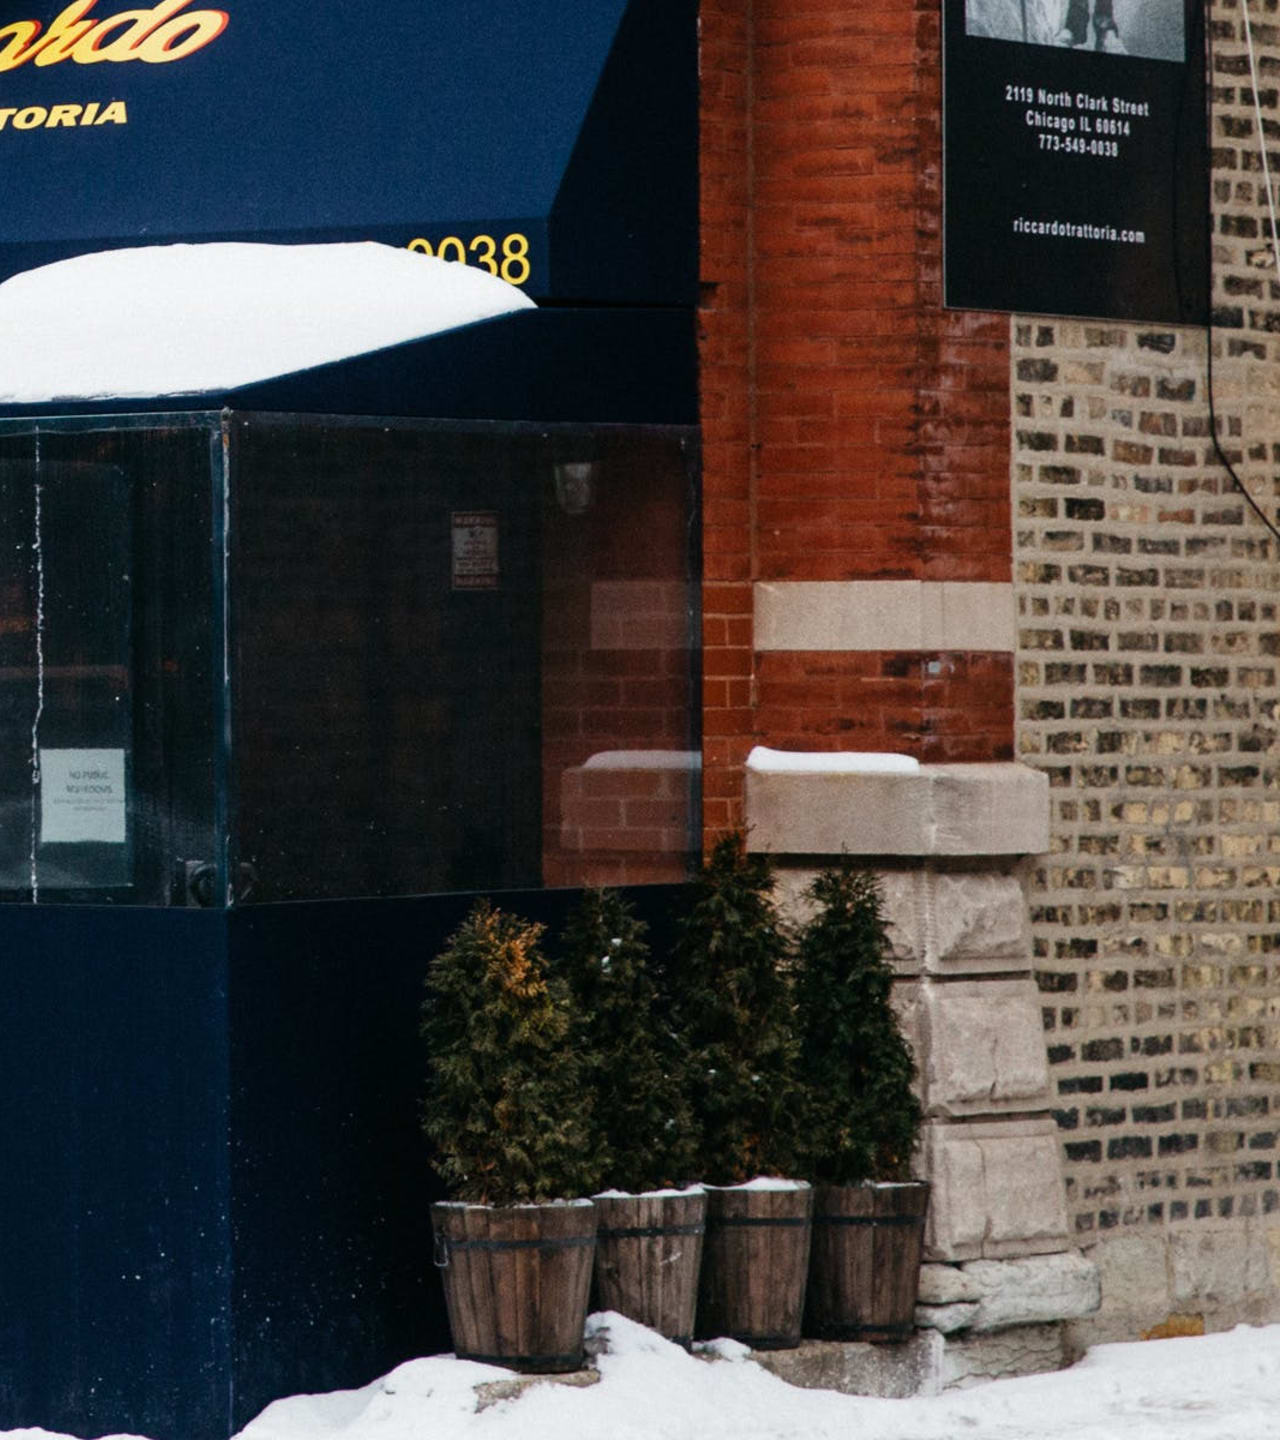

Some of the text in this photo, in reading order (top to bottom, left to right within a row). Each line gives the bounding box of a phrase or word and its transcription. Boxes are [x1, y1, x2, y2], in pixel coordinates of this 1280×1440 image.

[1005, 85, 1150, 117] 2119 North Clark Street
[1026, 110, 1131, 137] Chicago IL 60614
[1038, 134, 1119, 157] 773-549-0038
[1013, 217, 1145, 244] riccardotrattoria.com
